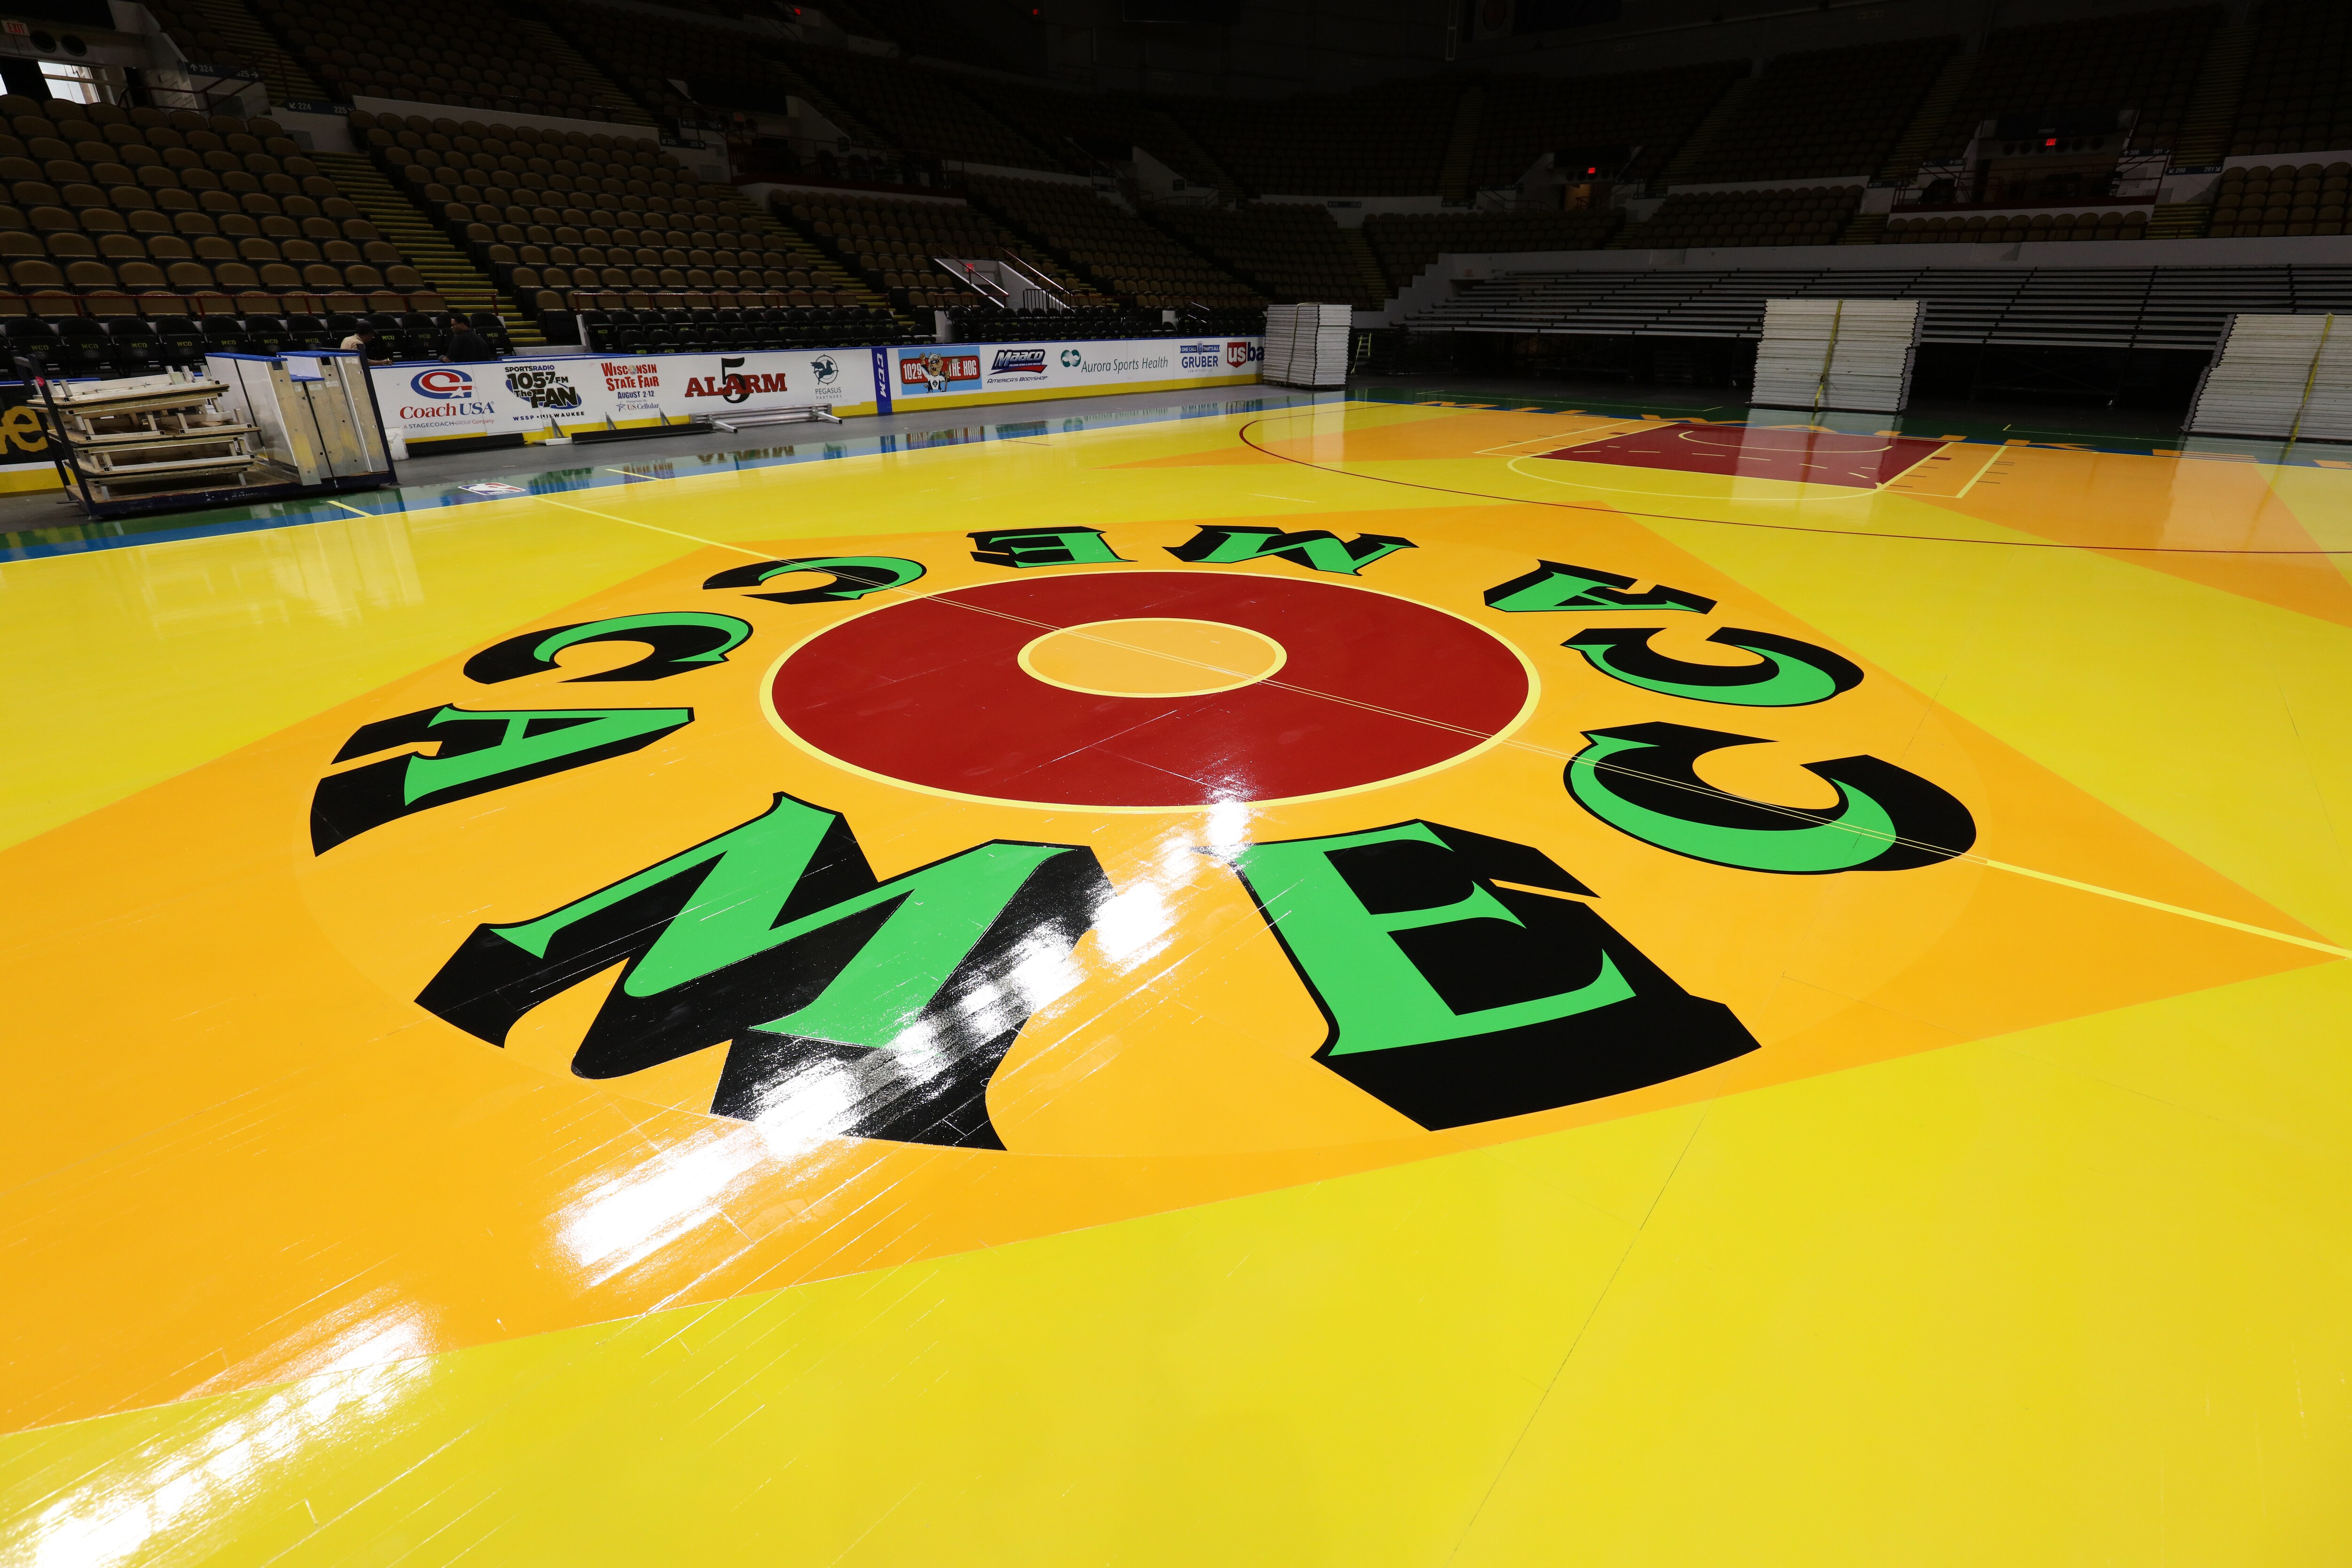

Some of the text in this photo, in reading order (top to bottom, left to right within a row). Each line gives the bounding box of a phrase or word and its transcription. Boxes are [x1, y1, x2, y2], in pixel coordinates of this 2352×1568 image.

[7, 22, 25, 34] EXIT
[297, 102, 311, 111] 224
[334, 106, 347, 114] 225
[963, 360, 977, 376] HOG
[1081, 356, 1168, 374] Aurora Sports Health
[1182, 355, 1218, 368] GRUBER
[606, 375, 660, 391] STATE FAIR
[721, 357, 750, 404] 5
[877, 353, 887, 398] CCM
[684, 373, 787, 398] ALARM
[529, 387, 578, 408] FAN
[400, 401, 495, 419] Coach USA
